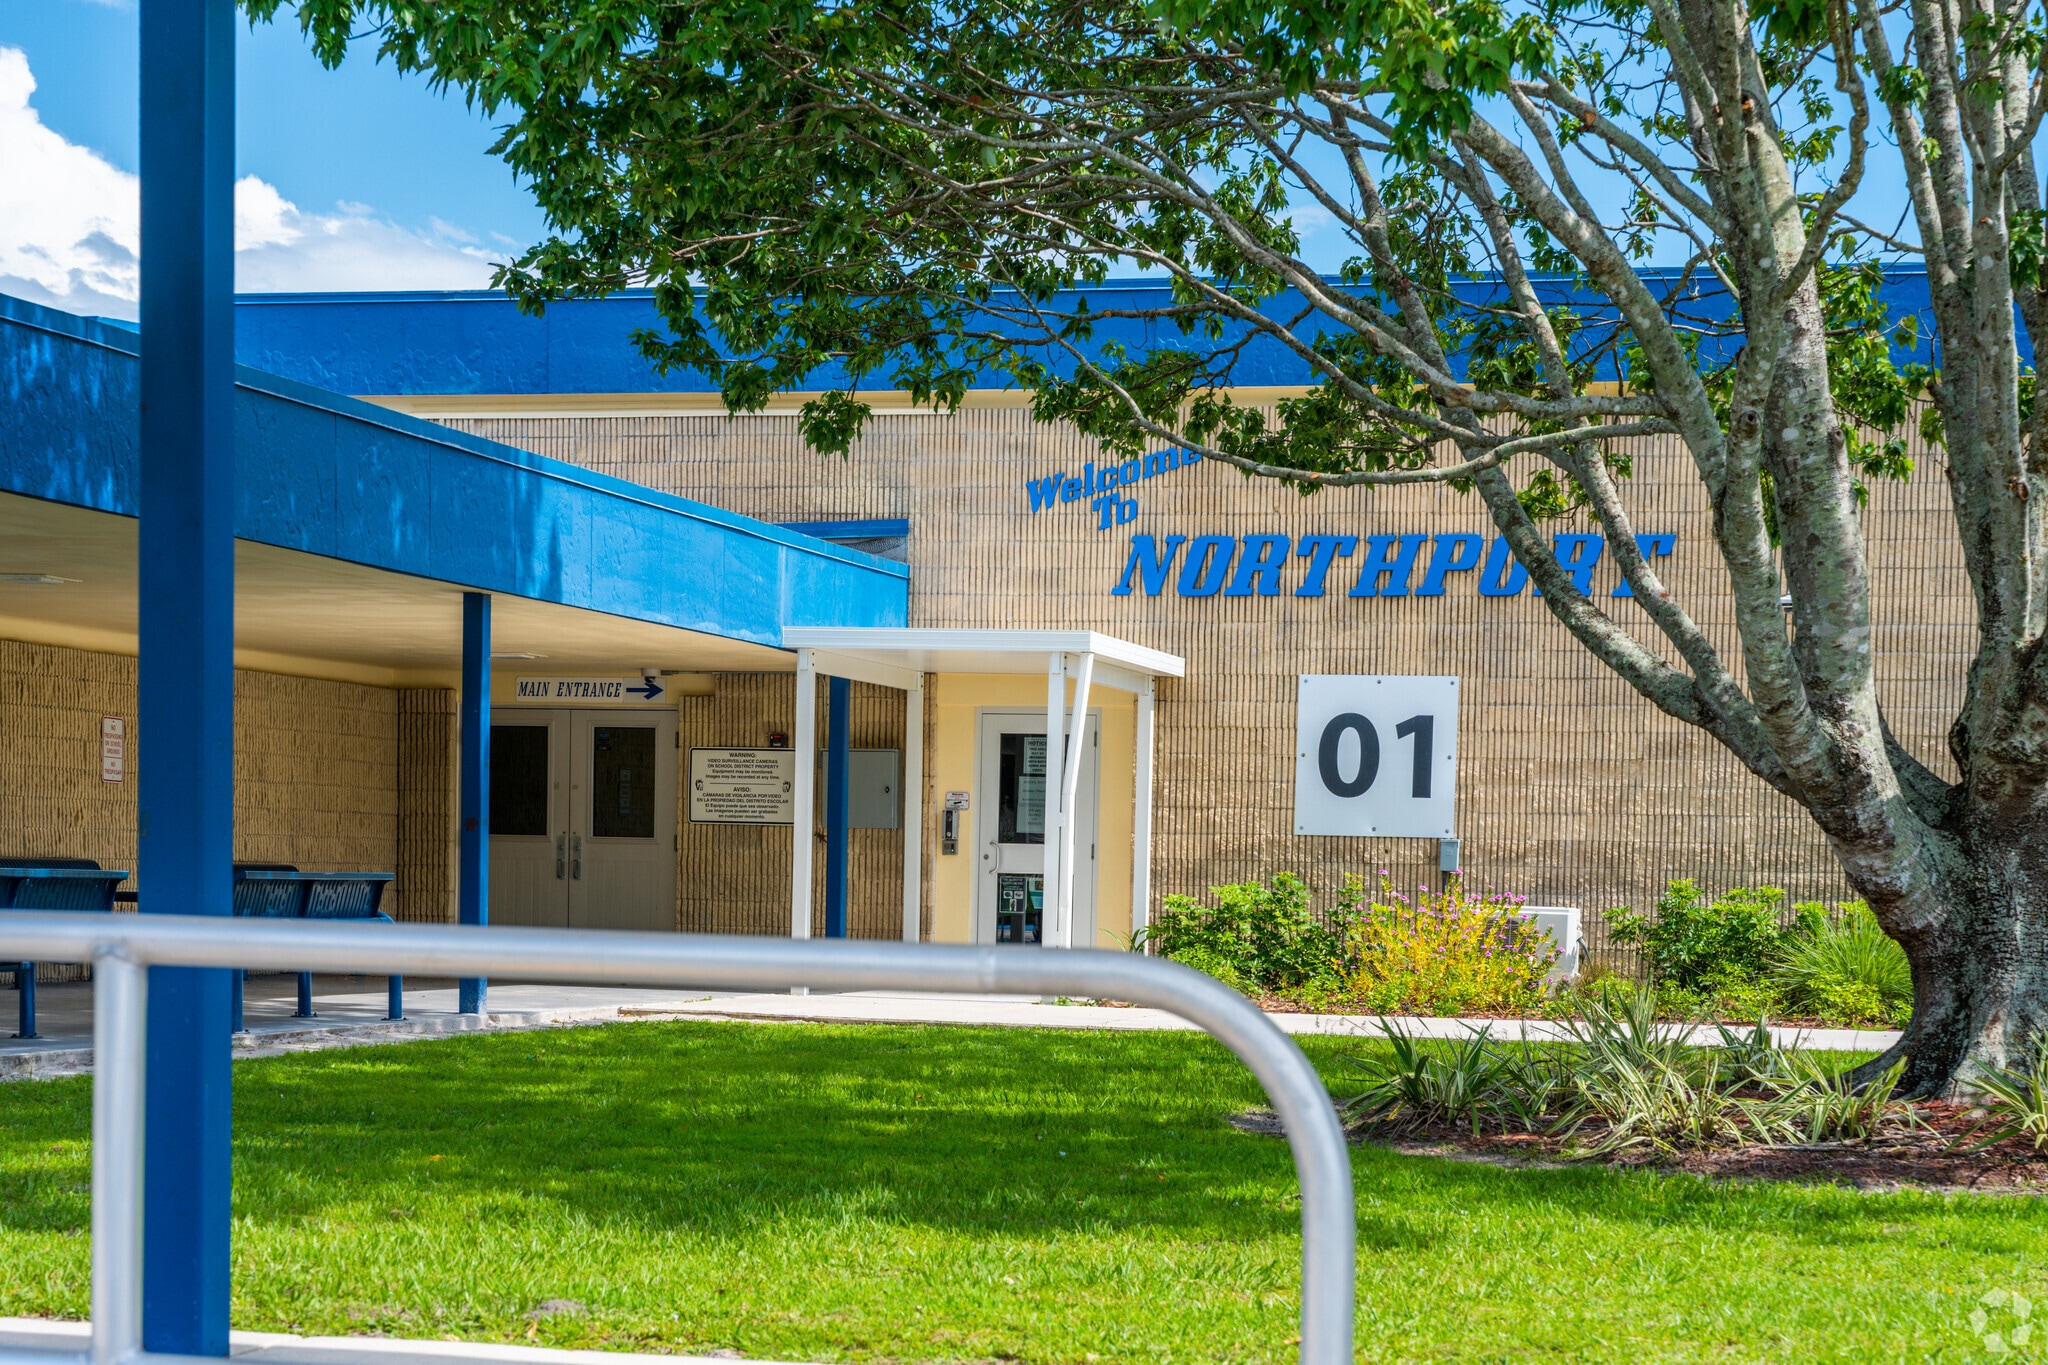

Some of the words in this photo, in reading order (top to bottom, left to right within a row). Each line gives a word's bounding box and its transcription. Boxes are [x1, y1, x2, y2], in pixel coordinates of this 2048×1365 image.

[1026, 447, 1203, 513] Welcome
[1092, 492, 1138, 531] To
[517, 681, 550, 697] MAIN
[556, 682, 622, 698] ENTRANCE
[1318, 712, 1434, 799] 01
